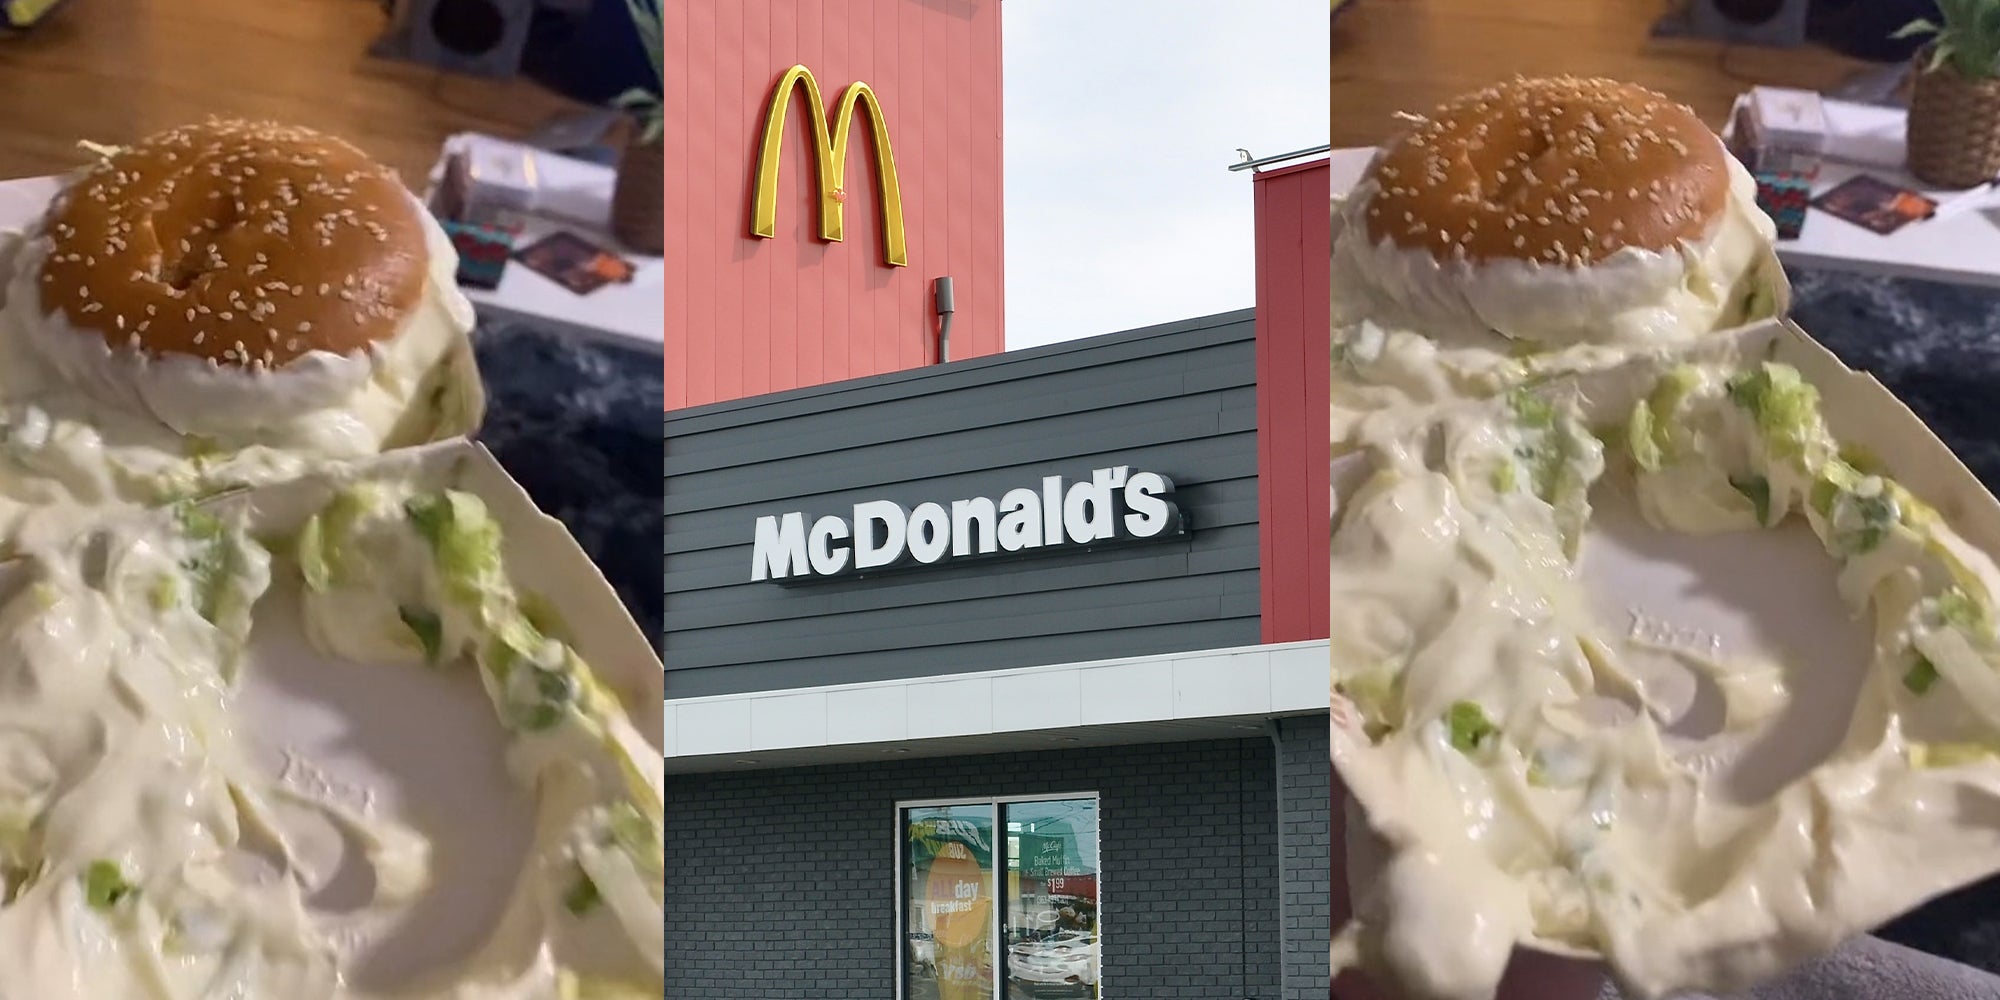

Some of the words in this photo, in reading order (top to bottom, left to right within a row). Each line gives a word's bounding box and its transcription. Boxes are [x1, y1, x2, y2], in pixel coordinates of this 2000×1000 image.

[750, 465, 1178, 582] McDonald's
[1034, 855, 1051, 866] Baked
[954, 880, 979, 901] day
[931, 900, 973, 914] breakfast
